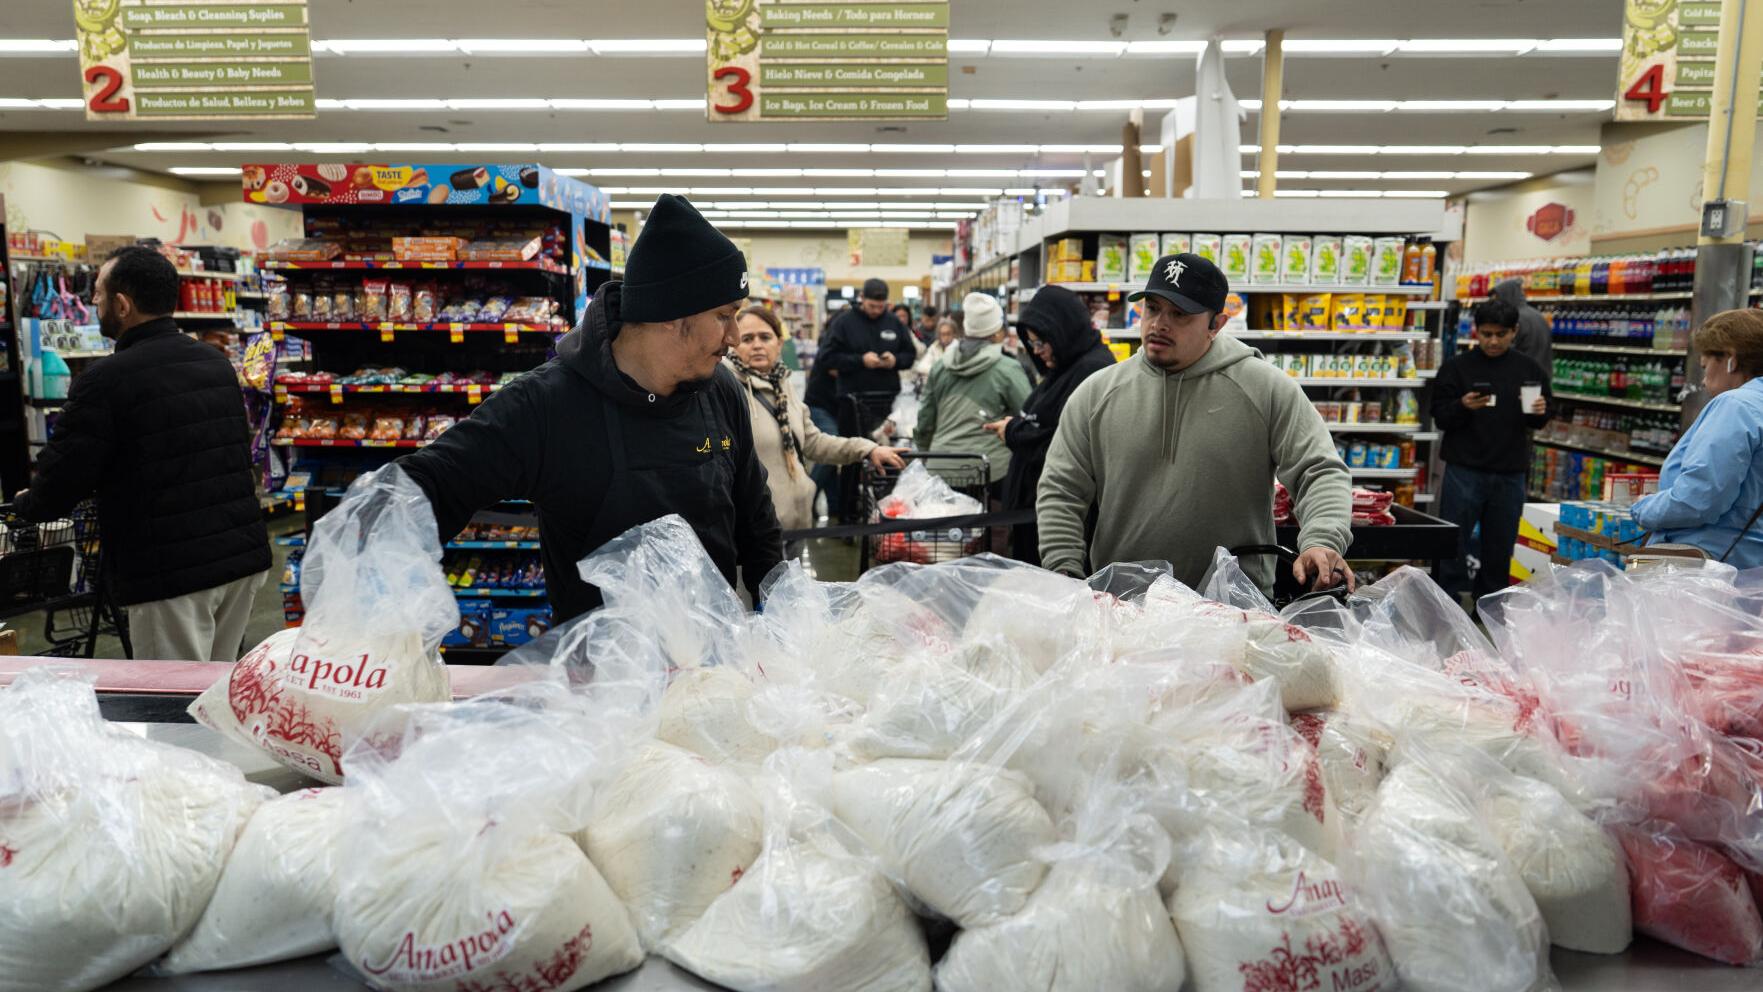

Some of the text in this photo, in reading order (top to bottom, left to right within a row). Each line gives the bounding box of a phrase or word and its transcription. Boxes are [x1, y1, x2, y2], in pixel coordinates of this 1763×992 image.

[155, 10, 187, 20] Bleach
[188, 10, 196, 20] &
[198, 9, 248, 22] Cleanning
[248, 9, 285, 22] Suplies
[766, 10, 801, 22] Baking
[803, 10, 833, 20] Needs
[844, 10, 868, 20] Todo
[869, 11, 892, 22] para
[894, 10, 936, 20] Hornear
[1683, 8, 1703, 17] Cold
[134, 41, 174, 50] Productos
[175, 41, 185, 50] de
[226, 40, 249, 51] Papel
[250, 42, 257, 51] y
[258, 40, 292, 51] Juguetes
[766, 41, 785, 50] Cold
[786, 41, 793, 50] &
[795, 41, 810, 50] Hot
[812, 41, 838, 50] Cereal
[840, 41, 847, 50] &
[880, 41, 915, 50] Cereales
[916, 41, 923, 50] &
[136, 67, 282, 80] Health & Beauty & Baby Needs
[766, 69, 925, 82] Hielo Nieve & Comida Congelada
[1681, 67, 1715, 79] Papita
[84, 65, 130, 113] 2
[714, 66, 754, 114] 3
[1624, 64, 1669, 114] 4
[141, 97, 187, 108] Productos
[188, 97, 201, 108] de
[233, 96, 267, 107] Belleza
[268, 98, 275, 109] y
[277, 96, 305, 107] Bebes
[766, 100, 780, 110] Ice
[809, 100, 824, 110] Ice
[825, 100, 858, 110] Cream
[859, 100, 868, 110] &
[870, 100, 904, 110] Frozen
[906, 99, 929, 110] Food
[1671, 98, 1695, 108] Beer
[1696, 97, 1705, 108] &
[376, 170, 403, 180] TASTE
[290, 653, 388, 690] apola
[340, 688, 363, 700] 1961
